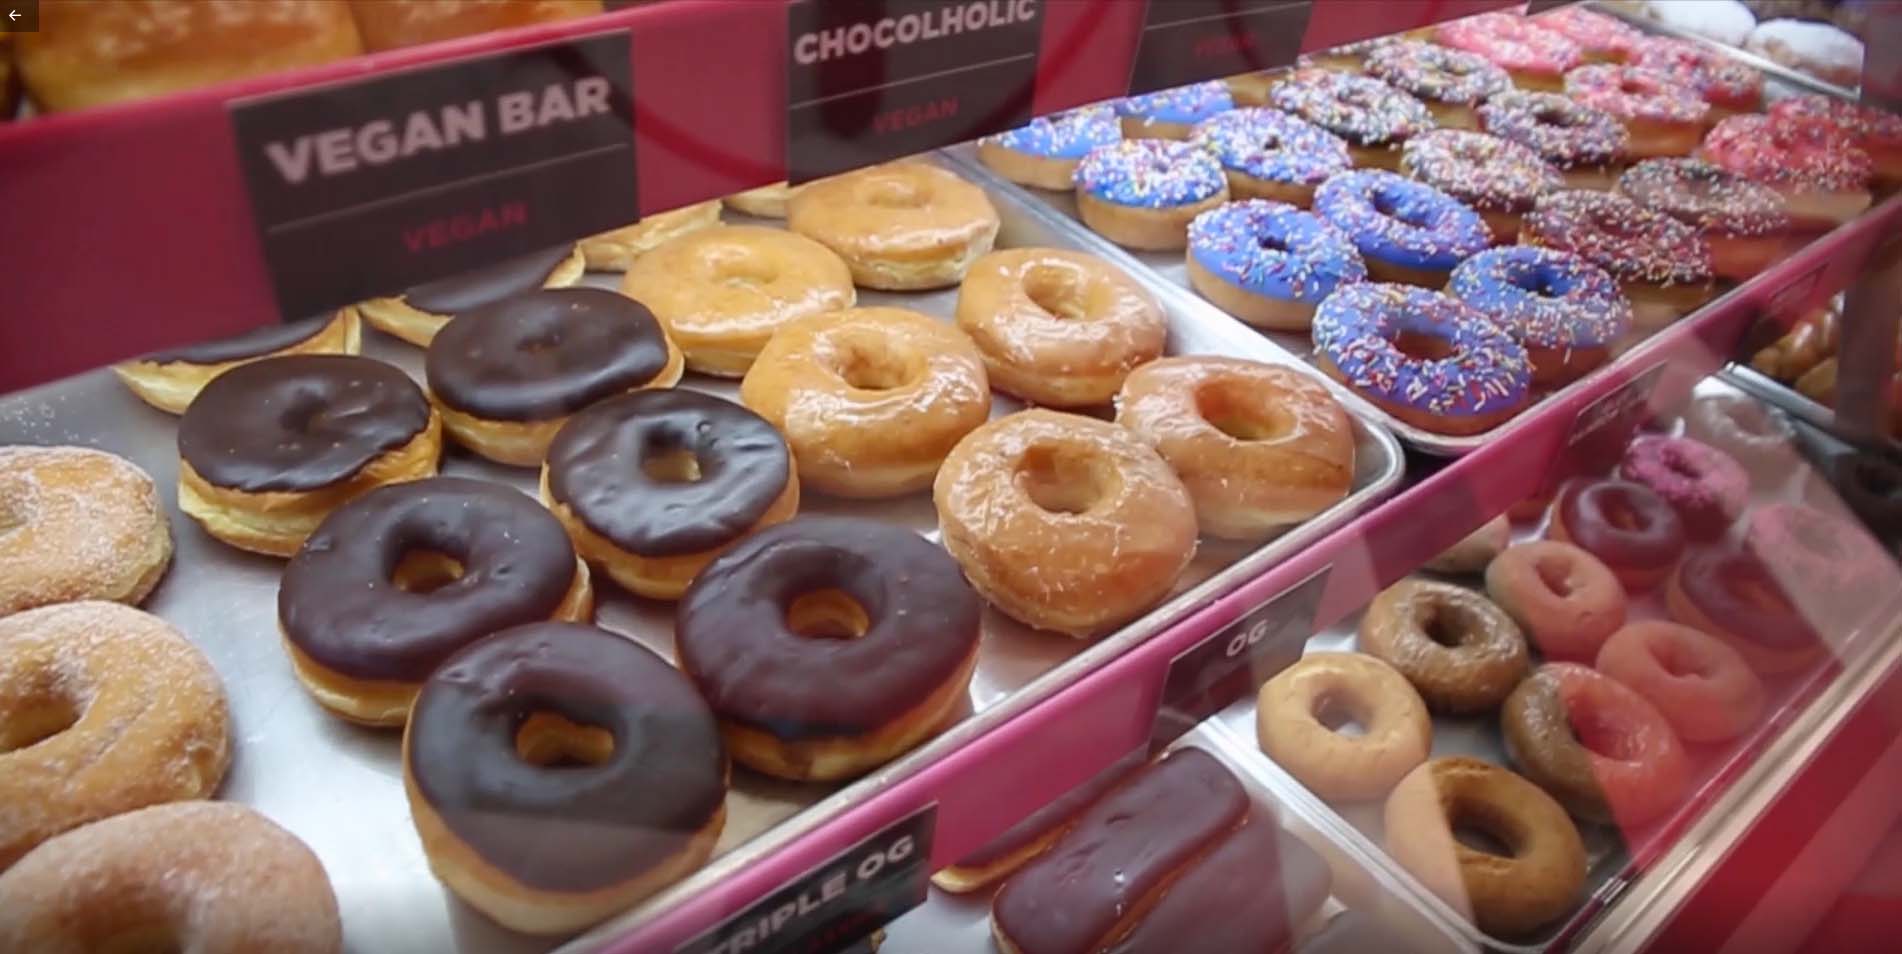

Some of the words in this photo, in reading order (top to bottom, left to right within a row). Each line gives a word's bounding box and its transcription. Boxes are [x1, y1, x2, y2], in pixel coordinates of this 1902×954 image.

[793, 0, 1036, 64] CHOCOLHOLIC
[264, 100, 485, 184] VEGAN
[498, 76, 612, 134] BAR
[872, 96, 960, 135] VEGAN
[402, 201, 528, 253] VEGAN
[1226, 619, 1269, 658] OG
[856, 835, 914, 880] OG
